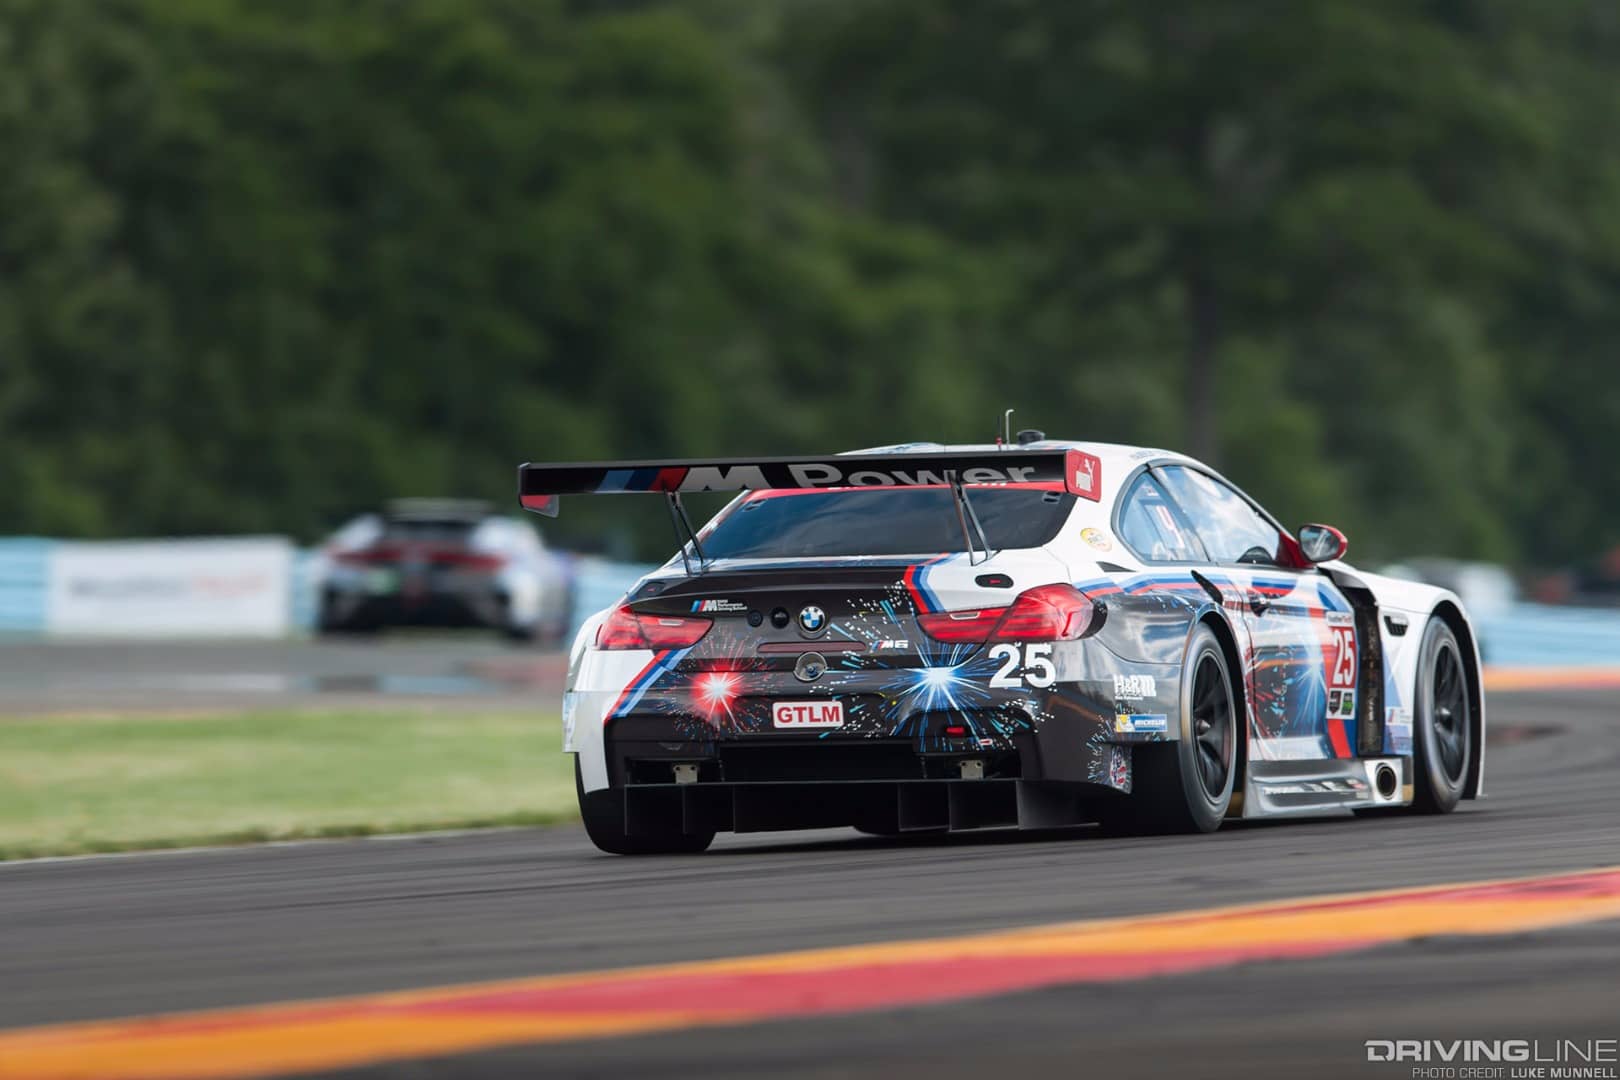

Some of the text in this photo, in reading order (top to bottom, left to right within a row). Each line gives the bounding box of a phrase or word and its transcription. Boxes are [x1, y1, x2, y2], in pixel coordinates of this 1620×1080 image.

[787, 463, 1036, 488] Power
[988, 642, 1057, 689] 25
[1332, 630, 1355, 686] 25
[776, 705, 840, 724] GTLM
